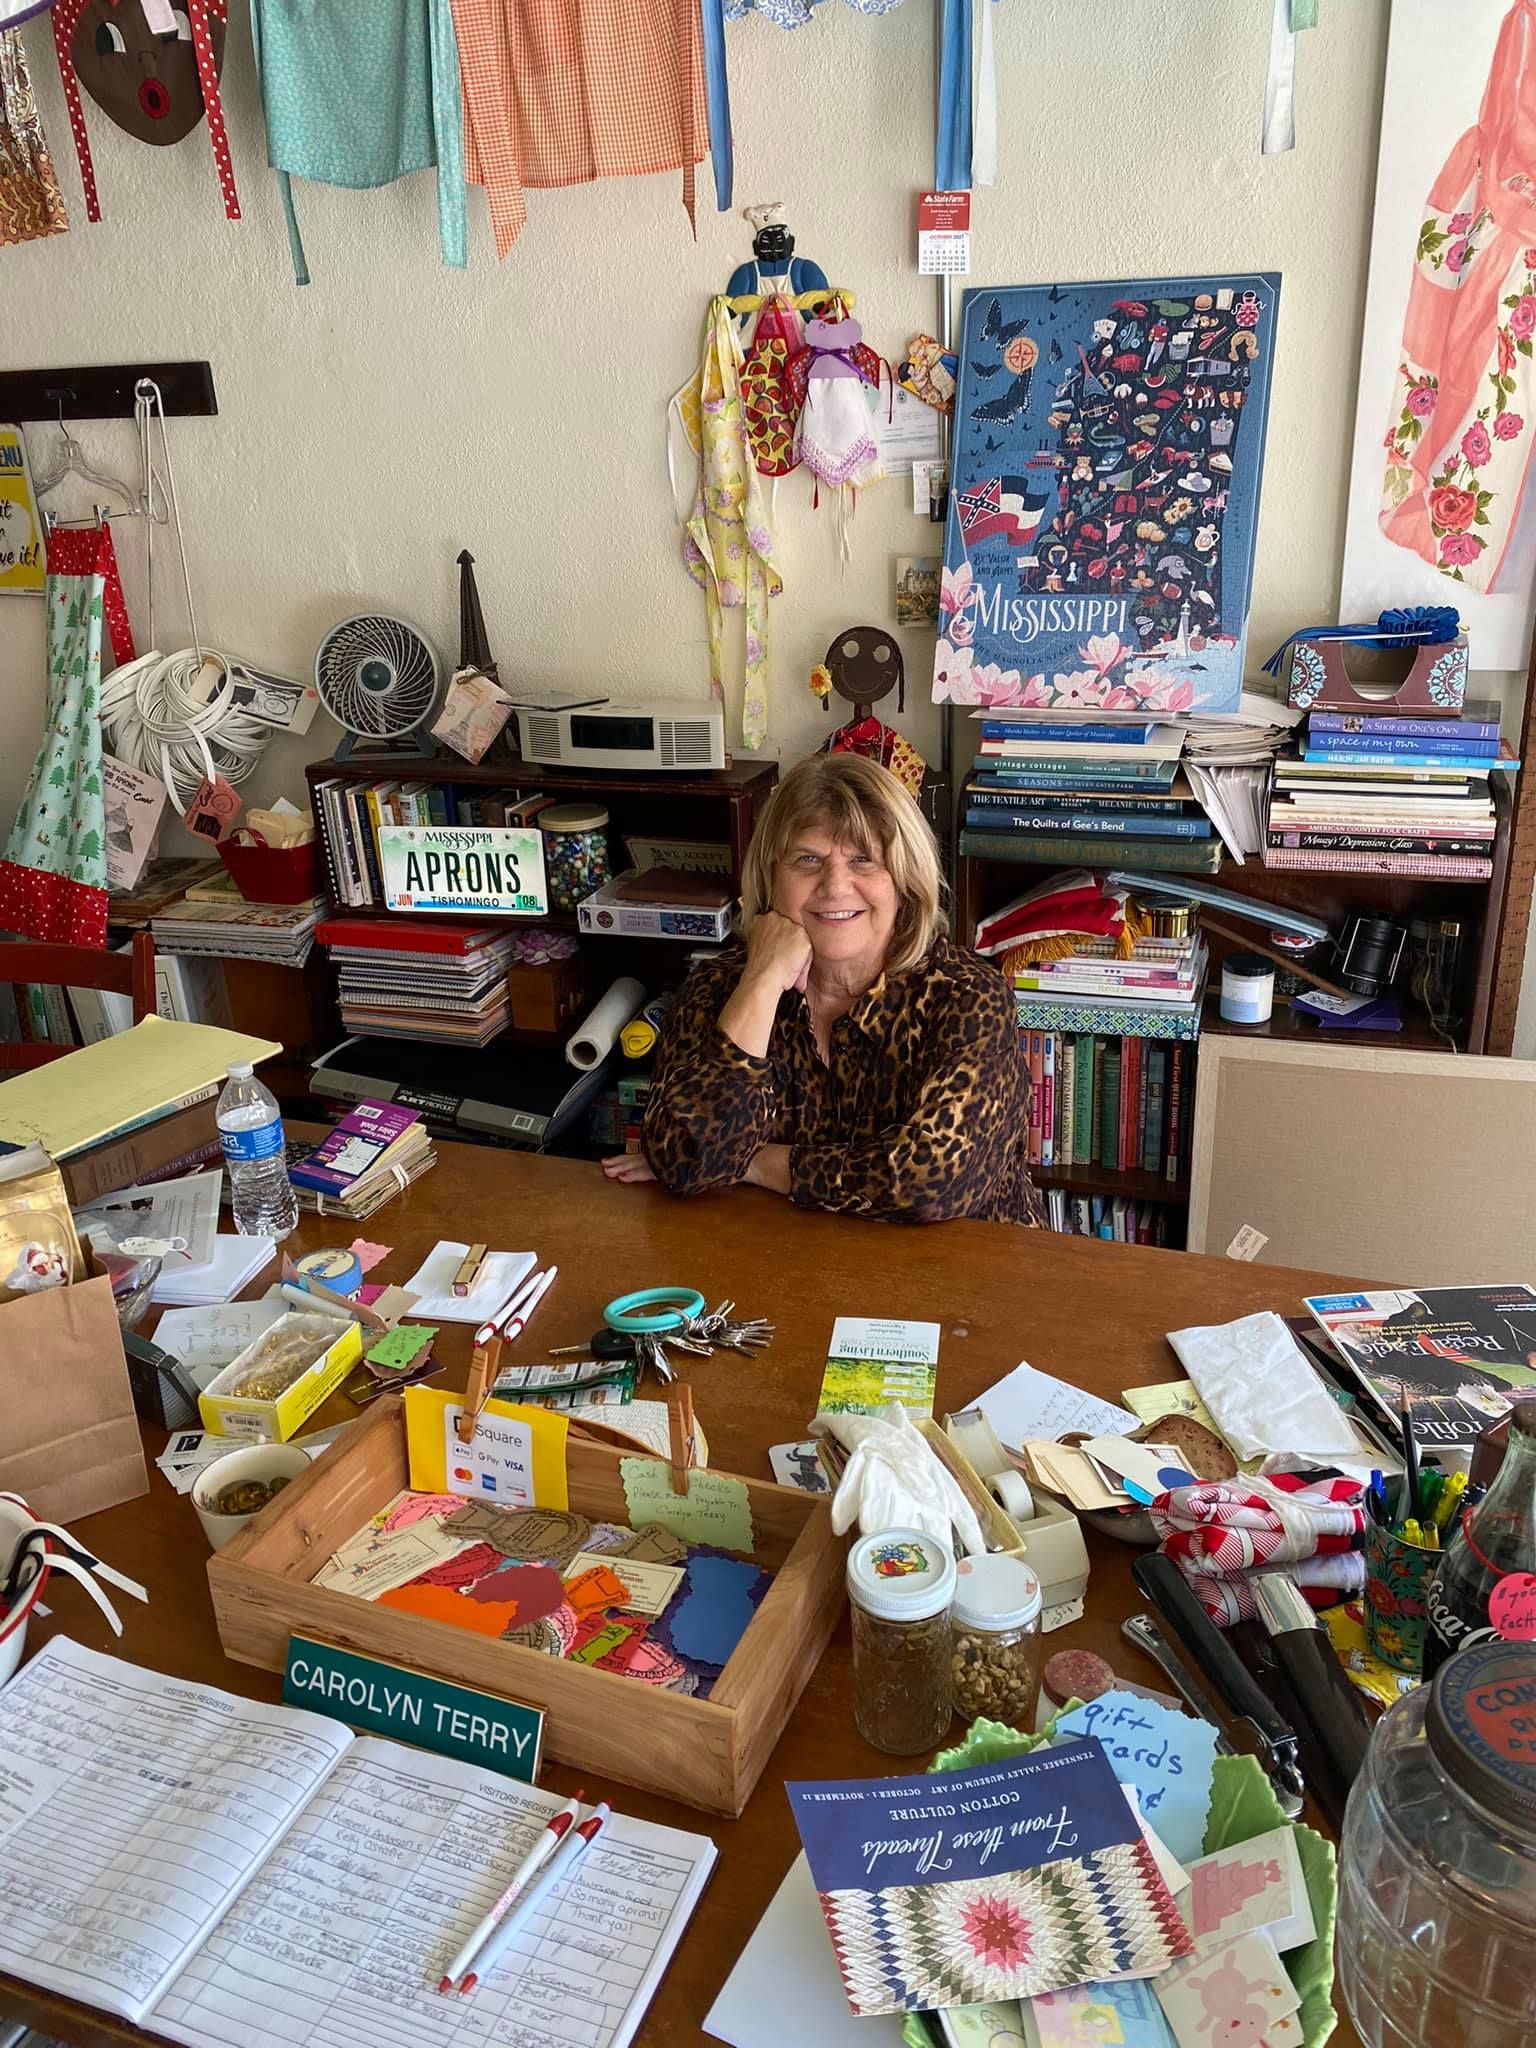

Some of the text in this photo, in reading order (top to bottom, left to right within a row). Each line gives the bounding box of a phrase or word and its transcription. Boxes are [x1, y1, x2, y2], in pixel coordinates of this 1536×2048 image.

[1327, 736, 1361, 748] space
[1362, 739, 1370, 748] of
[1372, 740, 1394, 752] my
[1395, 740, 1419, 748] own
[994, 761, 1067, 770] vintage cottages
[1018, 778, 1062, 787] SEASONS
[972, 794, 992, 805] THE
[993, 795, 1026, 806] TEXTILE
[1028, 796, 1046, 806] ART
[1098, 800, 1134, 809] MELANIE
[1137, 801, 1161, 810] PAINE
[1012, 818, 1125, 832] The Quilts of Gee's Bend
[1348, 826, 1380, 834] COUNTRY
[1401, 828, 1430, 836] CRAFTS
[424, 831, 494, 850] MISSISSIPPI
[1339, 835, 1388, 849] Depression
[1389, 838, 1413, 850] Glass
[406, 851, 522, 894] APRONS
[397, 894, 536, 908] JUN TISHOMINGO 08
[396, 1095, 426, 1105] ART
[839, 1344, 930, 1361] Southern Living
[1360, 1334, 1507, 1358] Regal Eagle
[474, 1424, 522, 1448] Square
[1413, 1420, 1484, 1440] rofile
[478, 1452, 485, 1460] G
[486, 1455, 500, 1466] Pay
[504, 1459, 524, 1472] VISA
[627, 1464, 659, 1480] Cash
[656, 1505, 692, 1521] Carolyn
[163, 1686, 236, 1713] VISITORS REGISTER
[290, 1660, 532, 1758] CAROLYN TERRY
[931, 1751, 1095, 1794] TENNESSEE VALLEY MUSEUM OF ART
[479, 1784, 558, 1817] VISITORS REGISTE
[814, 1792, 864, 1801] NOVEMBER
[880, 1788, 921, 1798] OCTOBER
[889, 1791, 1020, 1821] COTTON CULTURE
[861, 1805, 1079, 1874] From these Threads
[570, 1888, 586, 1901] So
[587, 1895, 615, 1914] many
